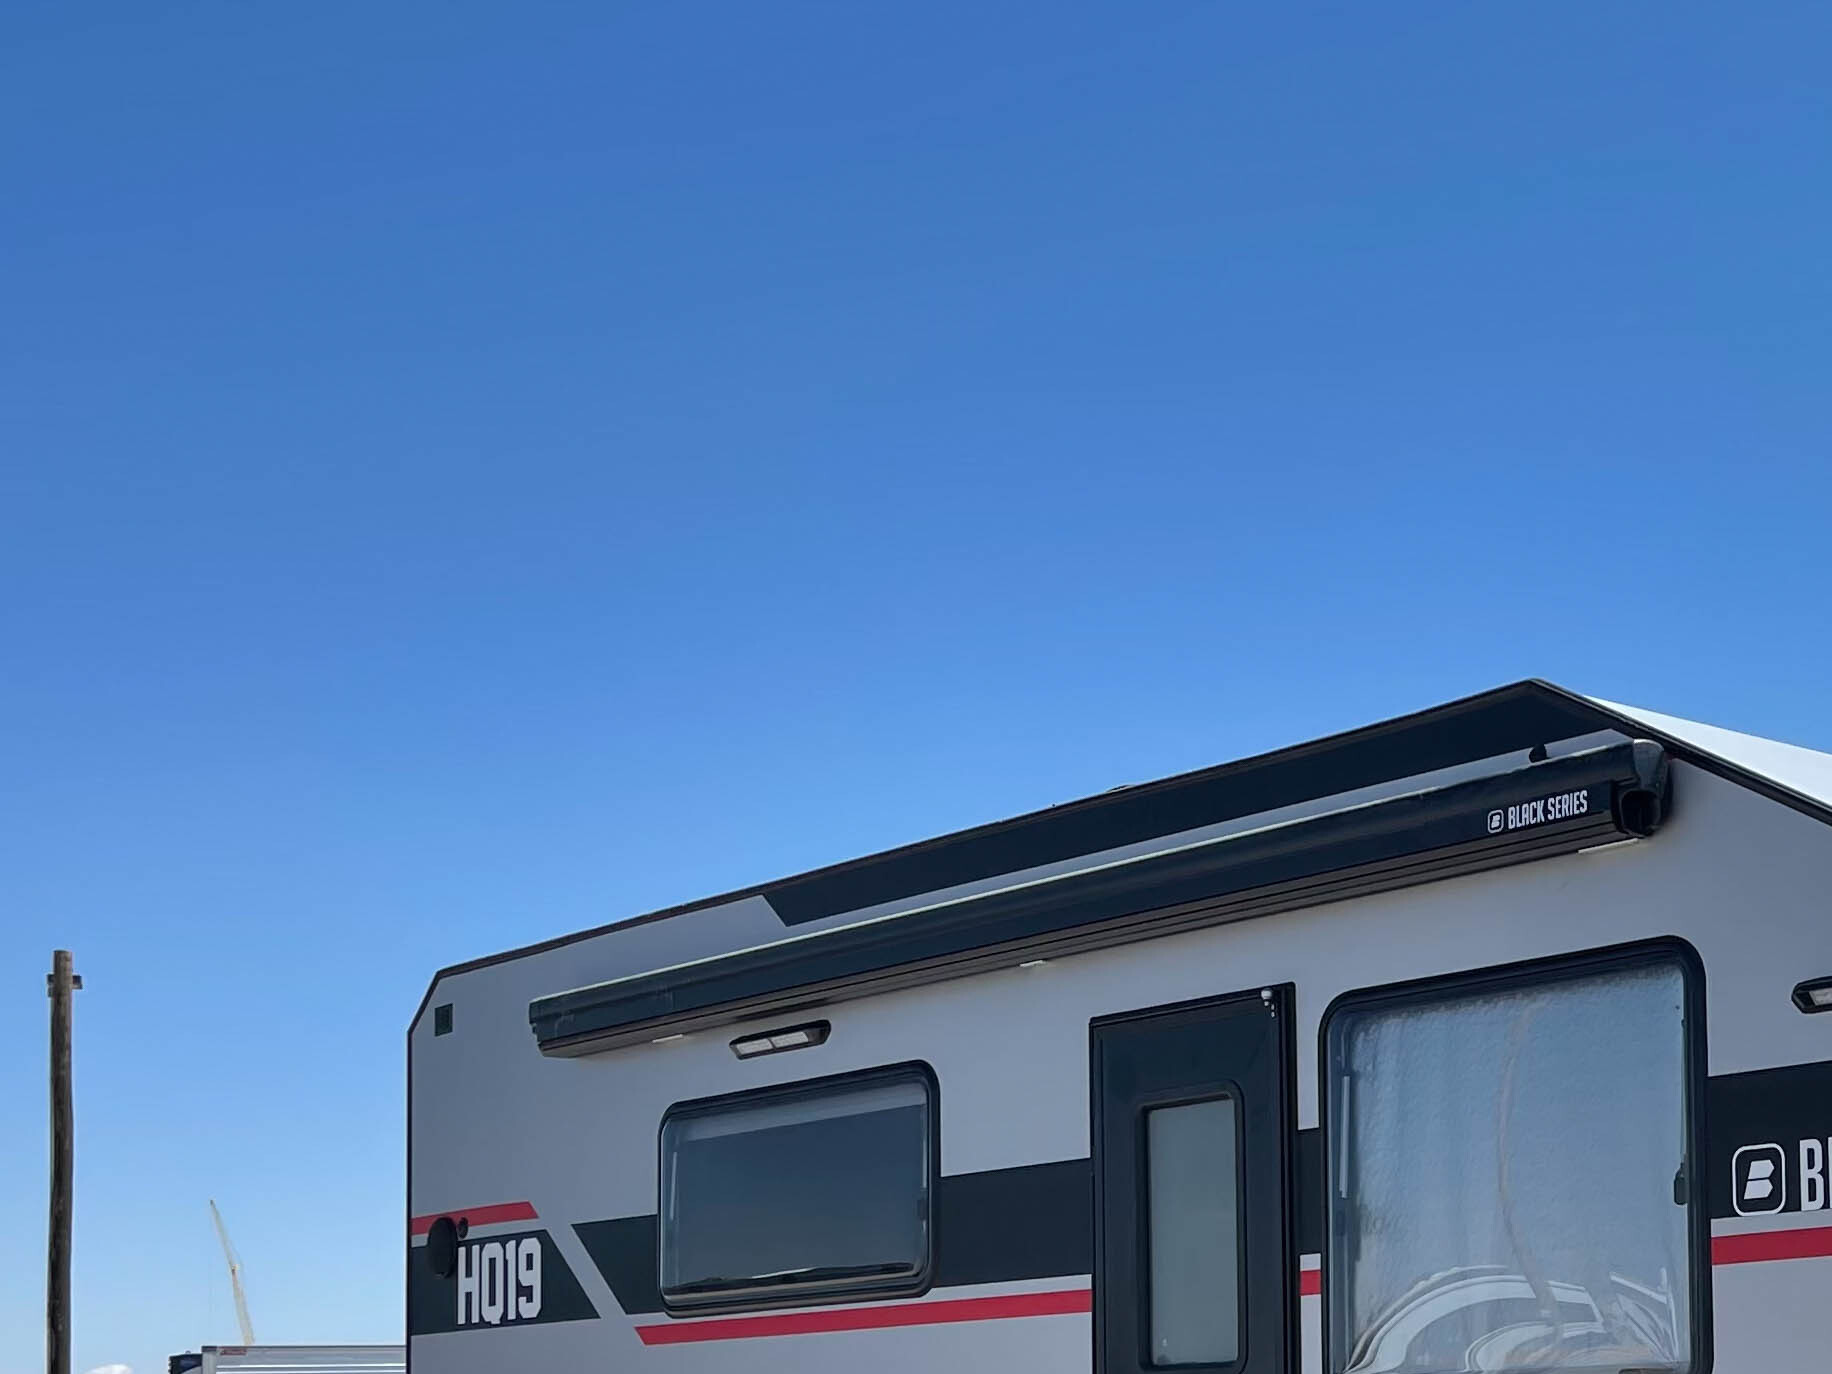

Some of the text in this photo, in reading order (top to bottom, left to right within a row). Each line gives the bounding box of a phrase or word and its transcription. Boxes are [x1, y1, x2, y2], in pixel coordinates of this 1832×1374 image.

[1507, 800, 1545, 830] BLACK
[1547, 790, 1588, 820] SERIES
[457, 1237, 542, 1325] HQ19
